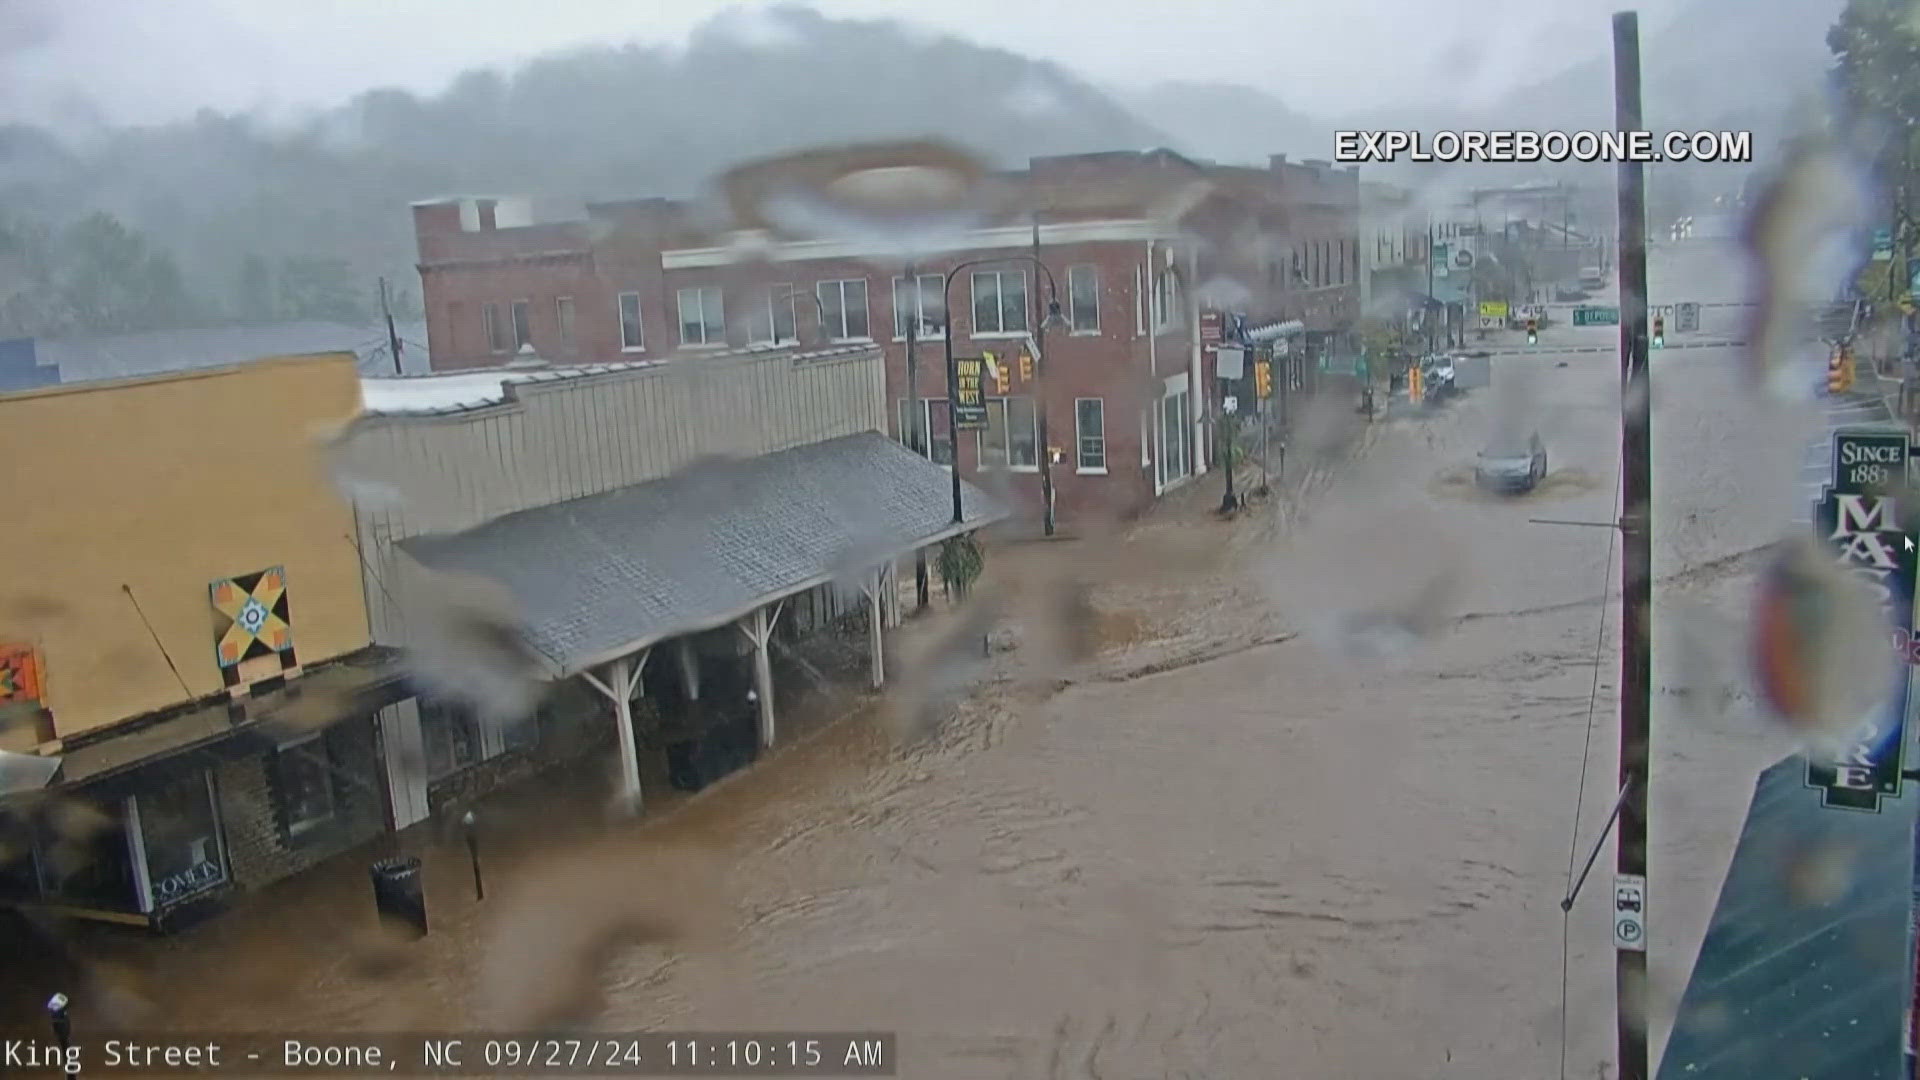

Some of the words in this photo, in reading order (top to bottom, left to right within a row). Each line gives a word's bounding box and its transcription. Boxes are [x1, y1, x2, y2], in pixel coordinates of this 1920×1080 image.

[957, 361, 980, 376] HORN
[966, 377, 979, 389] THE
[958, 390, 980, 405] WEST
[1850, 464, 1888, 485] 1883
